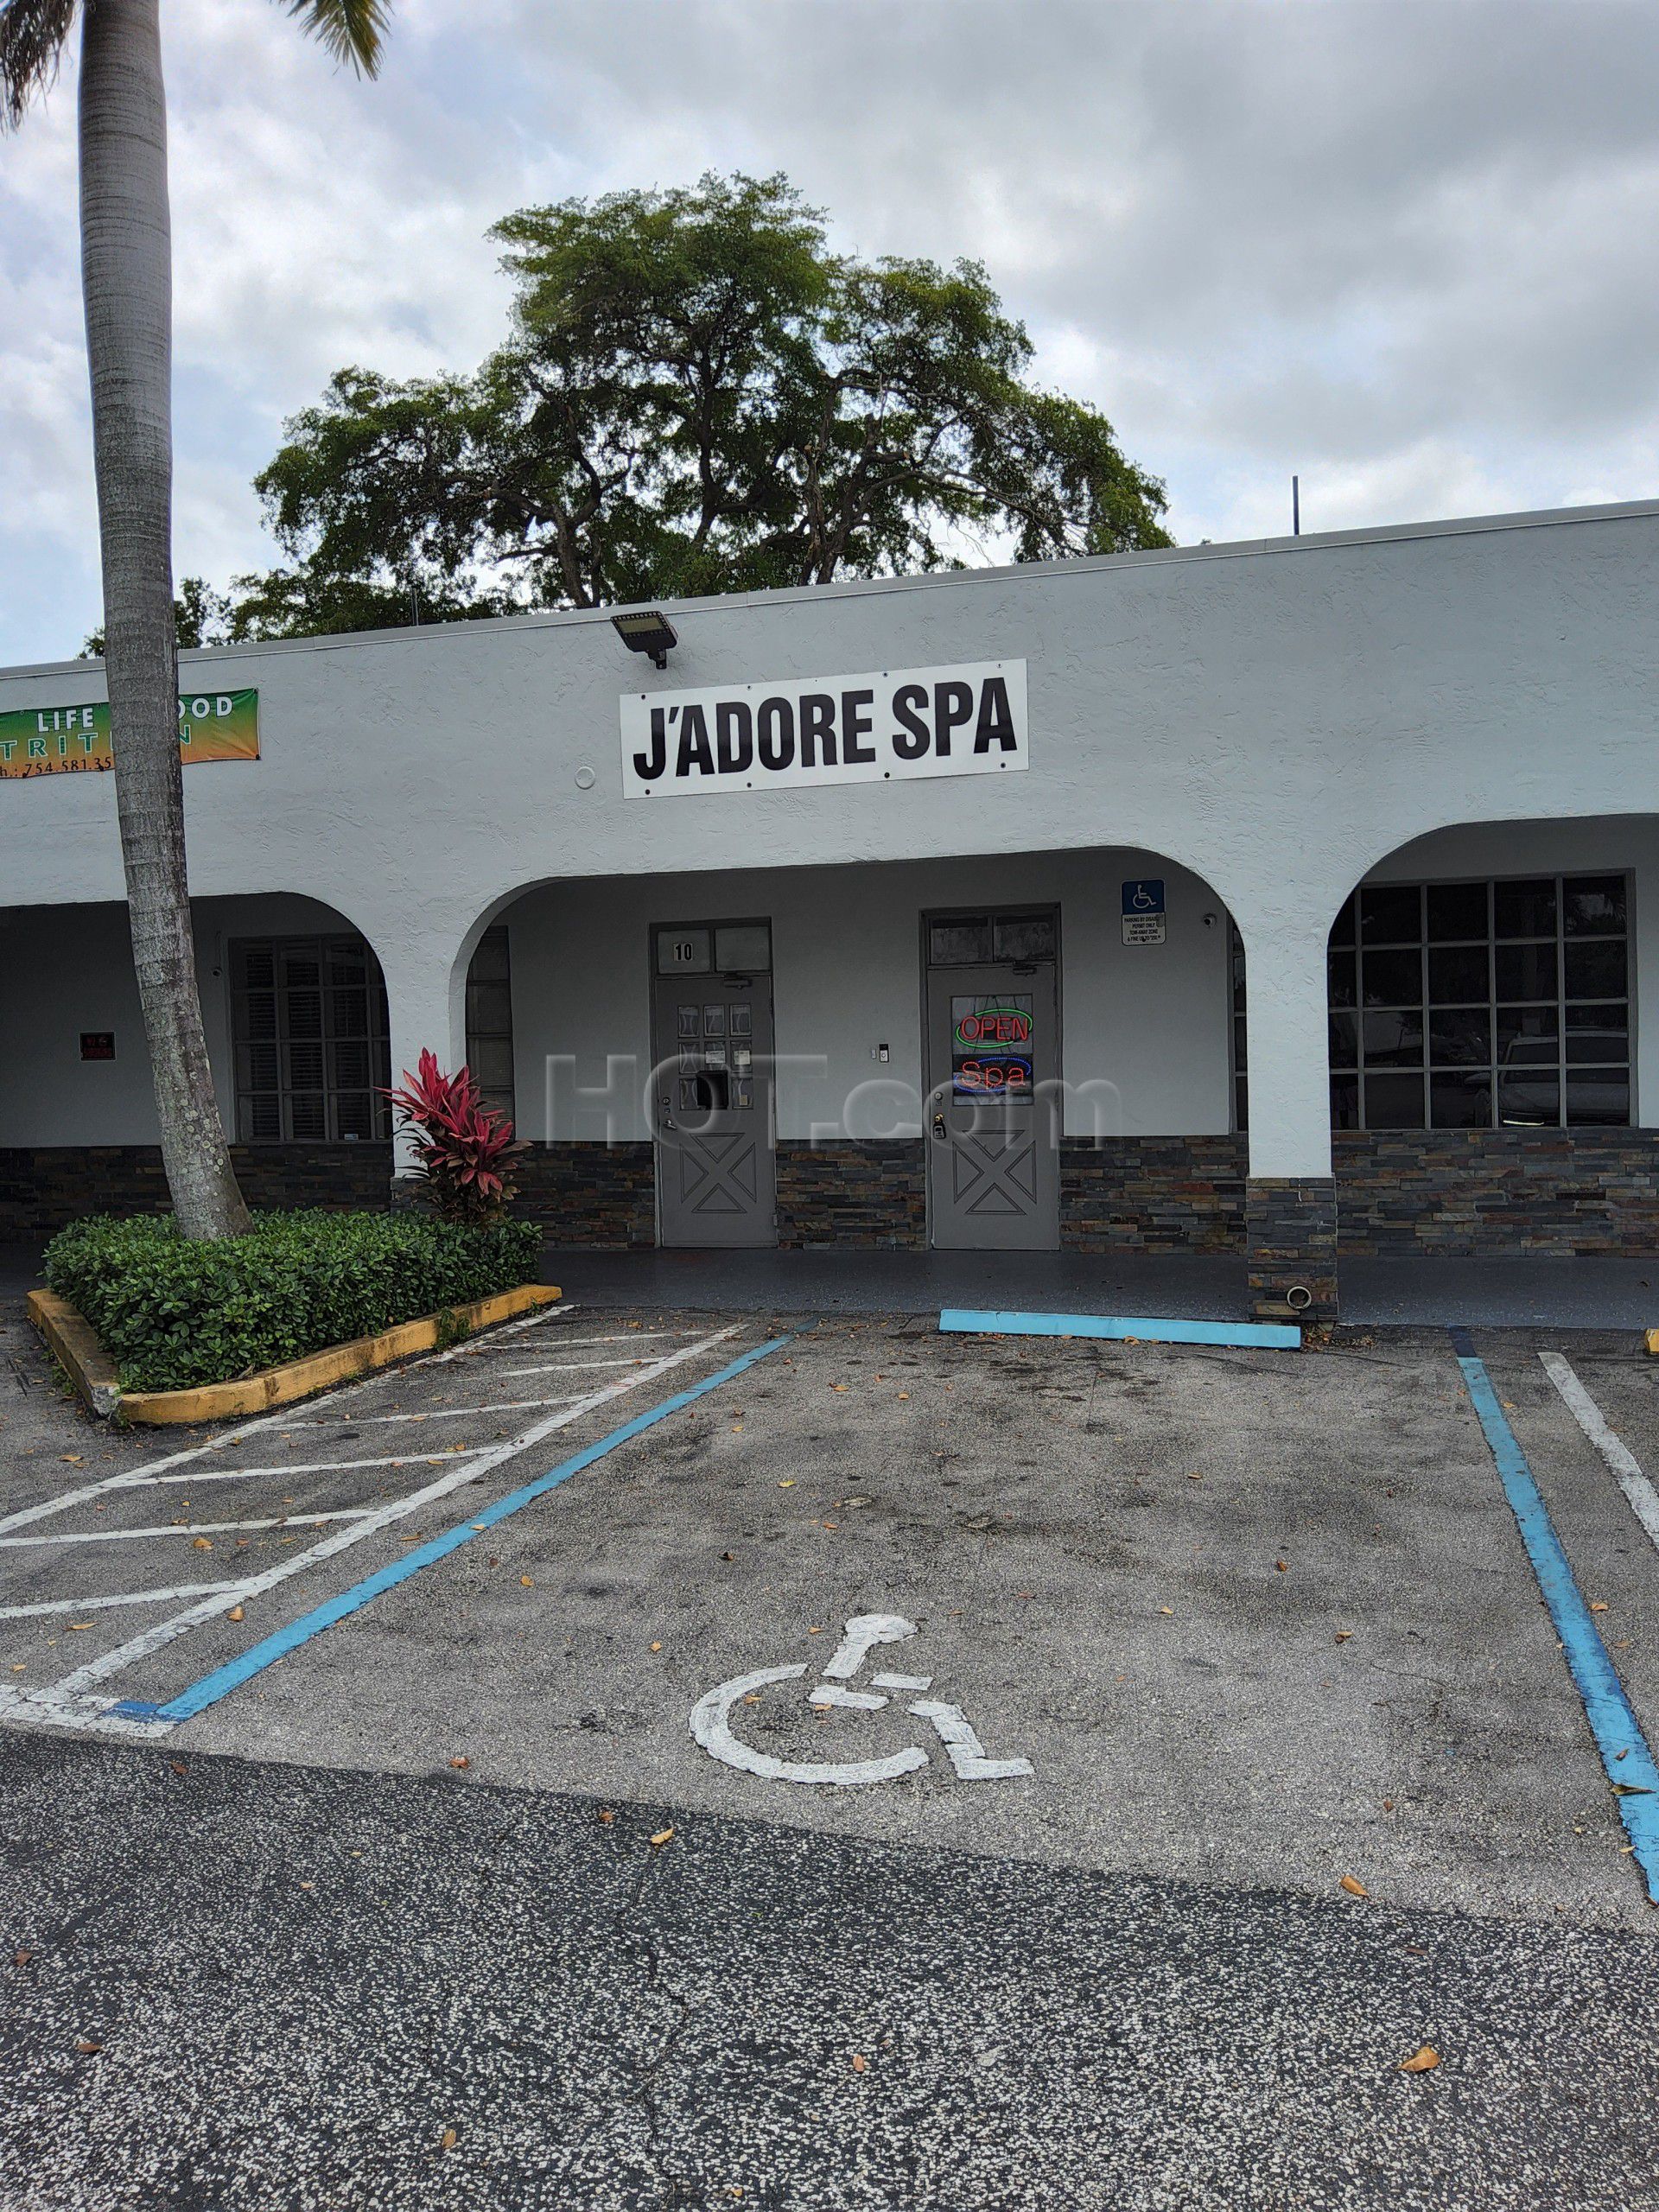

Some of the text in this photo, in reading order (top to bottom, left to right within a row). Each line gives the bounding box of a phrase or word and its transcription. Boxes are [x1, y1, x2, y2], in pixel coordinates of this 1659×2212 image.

[36, 707, 94, 733] LIFE
[632, 677, 1018, 780] J'ADORE SPA
[675, 943, 693, 961] 10
[961, 1015, 1028, 1041] OPEN
[961, 1061, 1026, 1090] Spa
